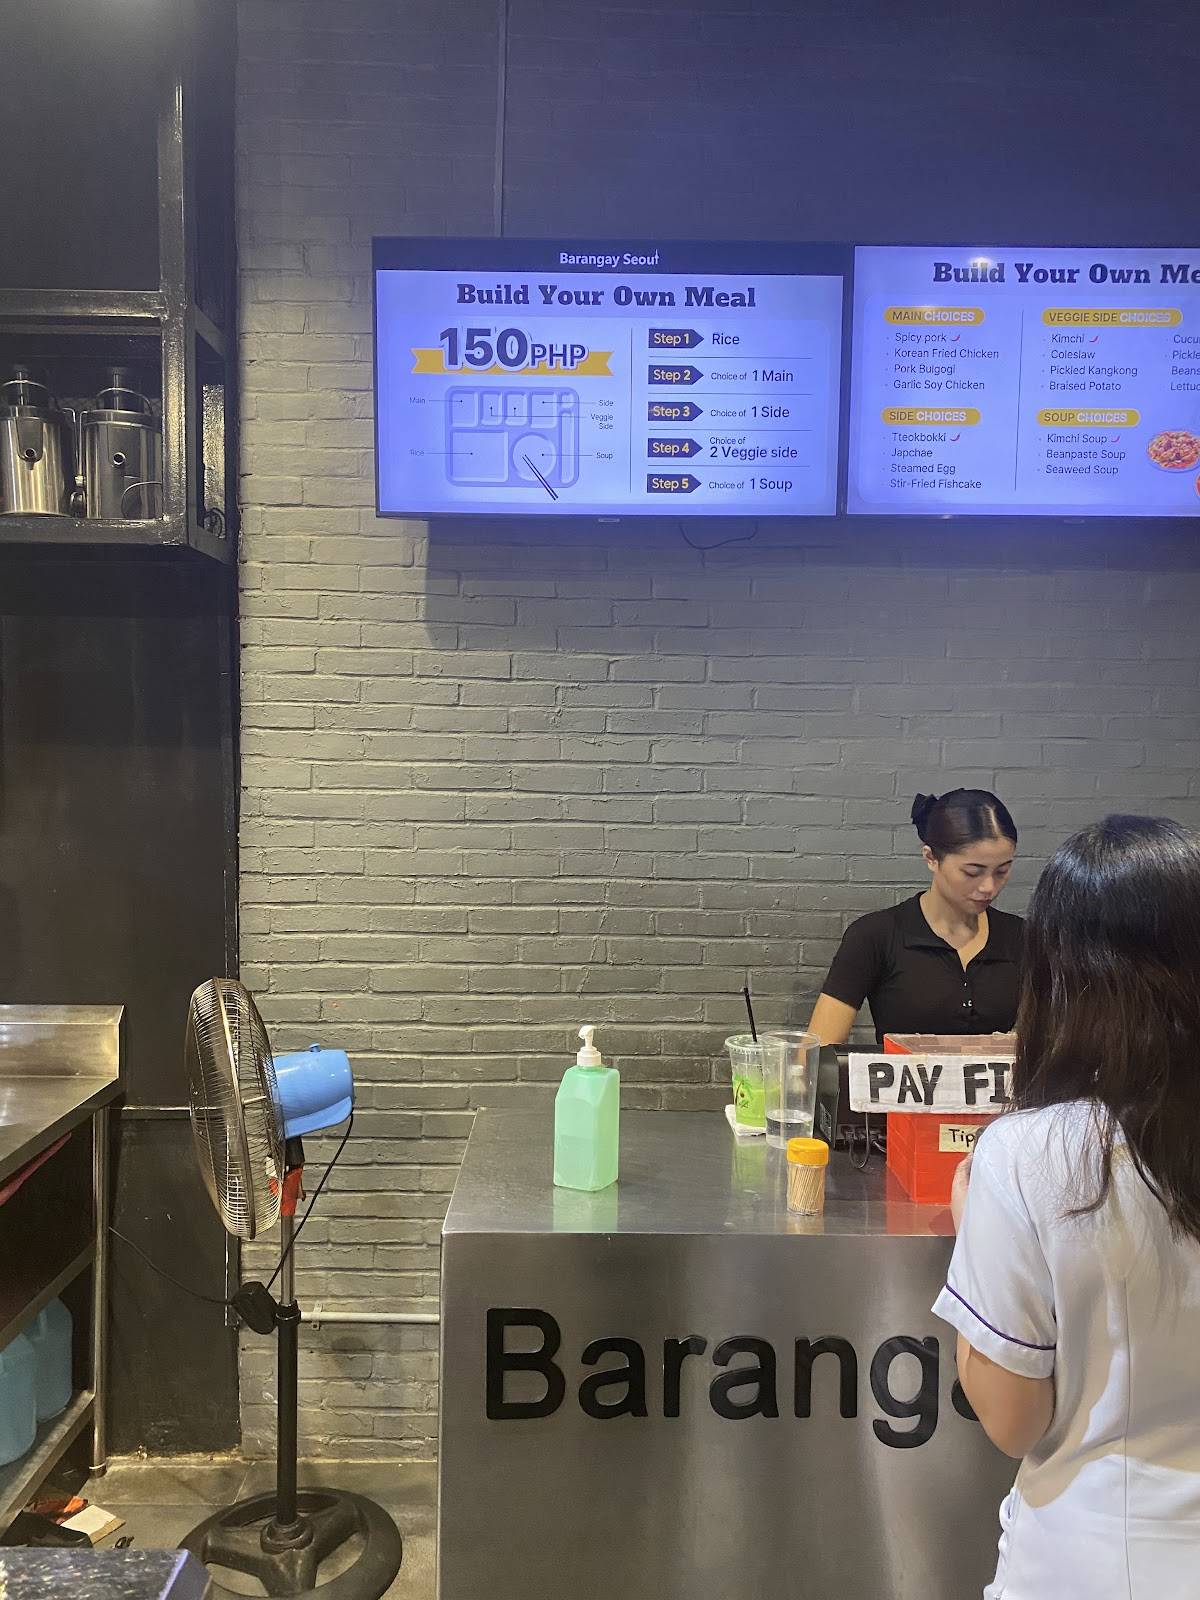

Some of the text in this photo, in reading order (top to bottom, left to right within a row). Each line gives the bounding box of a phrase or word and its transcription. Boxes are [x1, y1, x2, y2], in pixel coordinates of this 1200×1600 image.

[559, 249, 660, 268] Barangay Seoul
[933, 262, 1006, 283] Build
[1014, 262, 1080, 284] Your
[1088, 263, 1151, 284] Own
[456, 283, 756, 308] Build Your Own Meal
[892, 310, 976, 322] MAIN CHOICES
[1049, 312, 1172, 323] VEGGIE SIDE CHOICES
[653, 332, 690, 347] Step 1
[711, 333, 740, 345] Rice
[895, 332, 947, 344] Spicy pork
[1051, 333, 1085, 344] Kimchi
[1173, 334, 1200, 344] Cucu
[894, 348, 999, 359] Korean Fried Chicken
[1051, 349, 1096, 360] Coleslaw
[653, 369, 691, 383] Step 2
[710, 369, 794, 382] Choice of 1 Main
[894, 364, 956, 376] Pork Bulgogi
[1050, 365, 1138, 377] Pickled Kangkong
[893, 379, 985, 391] Garlic Soy Chicken
[1049, 381, 1122, 391] Braised Potato
[598, 399, 614, 407] Side
[590, 413, 614, 422] Veggie
[652, 405, 690, 420] Step 3
[710, 405, 790, 419] Choice of 1 Side
[889, 411, 967, 422] SIDE CHOICES
[1044, 412, 1128, 423] SOUP CHOICES
[598, 422, 614, 430] Side
[709, 436, 746, 445] Choice of
[1047, 433, 1108, 445] Kimchi Soup
[652, 442, 690, 456] Step 4
[709, 445, 798, 461] 2 Veggie side
[891, 448, 933, 459] Japchae
[596, 452, 614, 461] Soup
[1046, 450, 1126, 461] Beanpaste Soup
[890, 463, 956, 475] Steamed Egg
[1045, 465, 1119, 476] Seaweed Soup
[651, 478, 689, 492] Step 5
[708, 478, 793, 493] Choice of 1 Soup
[890, 478, 982, 489] Stir-Fried Fishcake
[867, 1061, 1016, 1106] PAY FI
[948, 1128, 975, 1148] Tip
